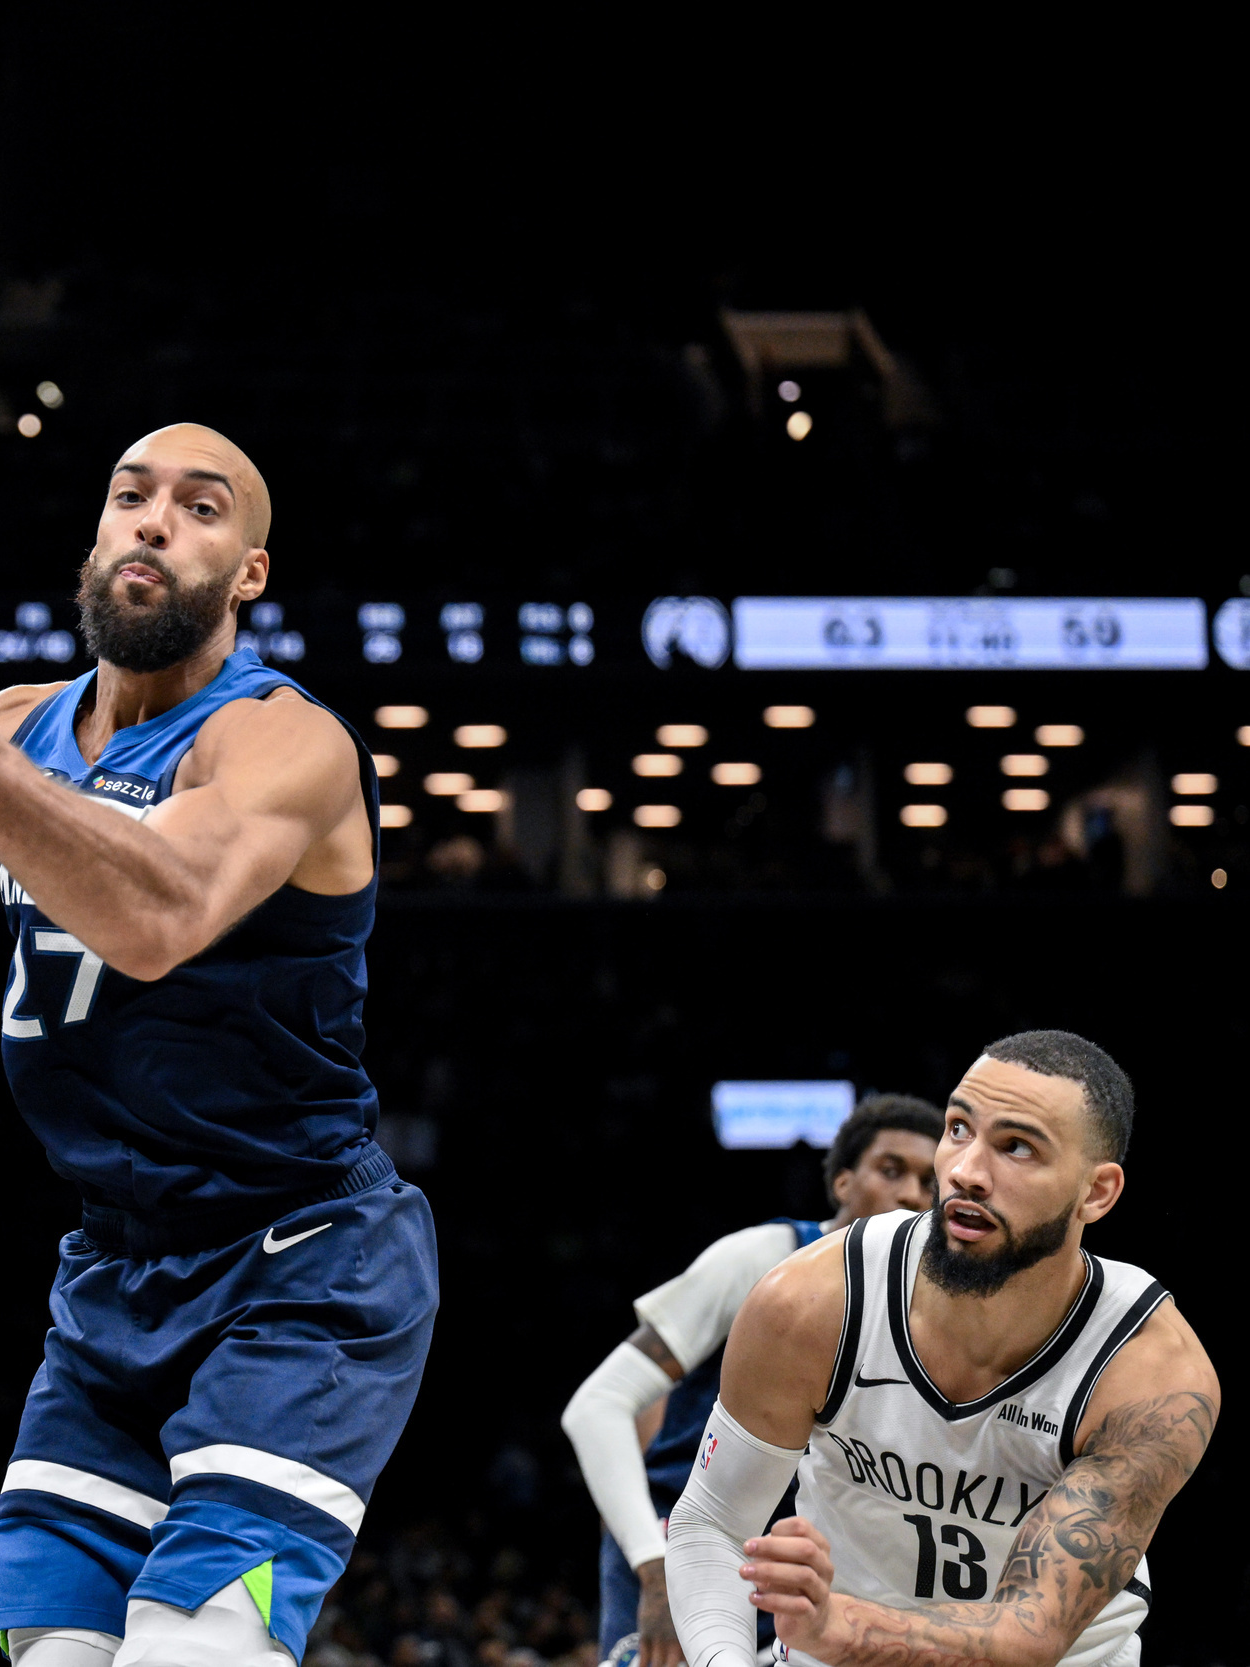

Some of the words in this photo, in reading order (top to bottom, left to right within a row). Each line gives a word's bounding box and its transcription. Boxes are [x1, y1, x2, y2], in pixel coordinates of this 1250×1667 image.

[103, 780, 155, 800] sezzle
[2, 930, 104, 1038] 27
[997, 1403, 1017, 1423] All
[1016, 1407, 1028, 1428] In
[1031, 1411, 1058, 1437] Won
[827, 1431, 1049, 1527] BROOKLY
[903, 1513, 988, 1600] 13
